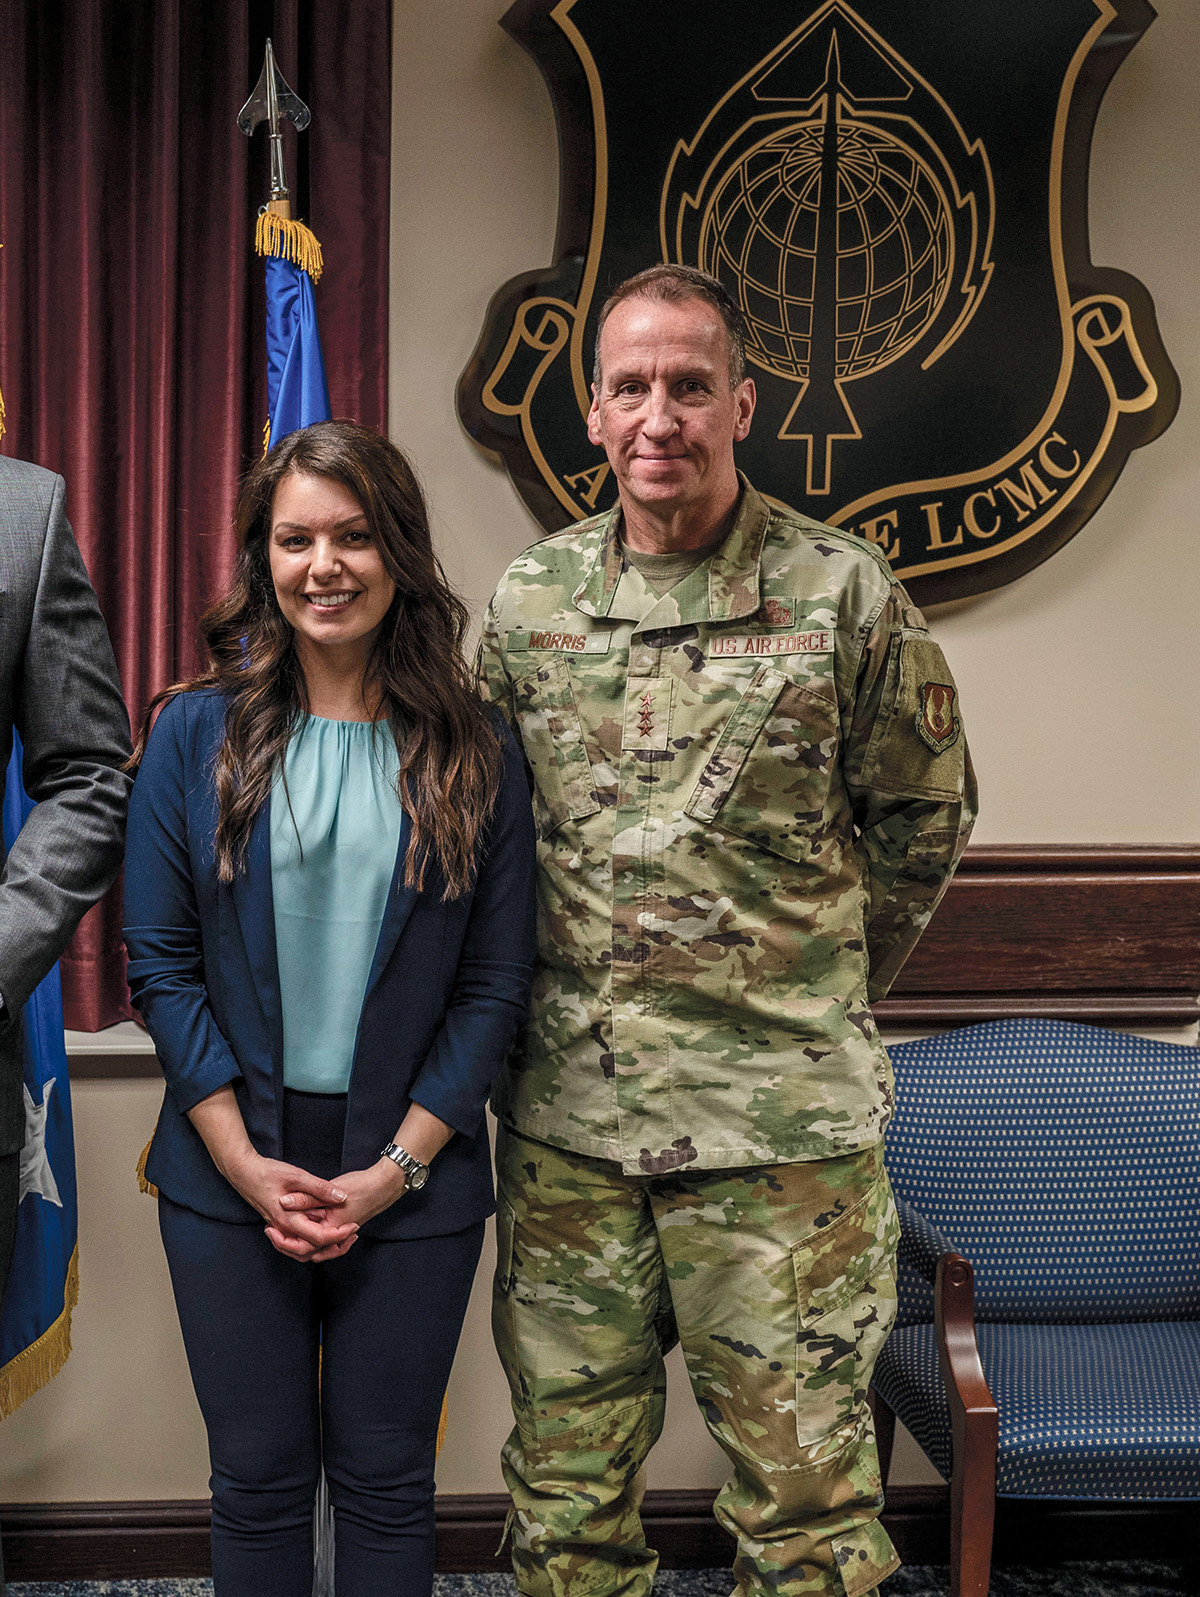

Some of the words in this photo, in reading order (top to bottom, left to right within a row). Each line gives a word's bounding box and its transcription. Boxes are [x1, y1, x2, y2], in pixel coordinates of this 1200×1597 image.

[920, 431, 1081, 550] LCMC
[528, 631, 587, 651] MORRIS
[744, 636, 772, 654] AIR
[776, 632, 829, 653] FORCE
